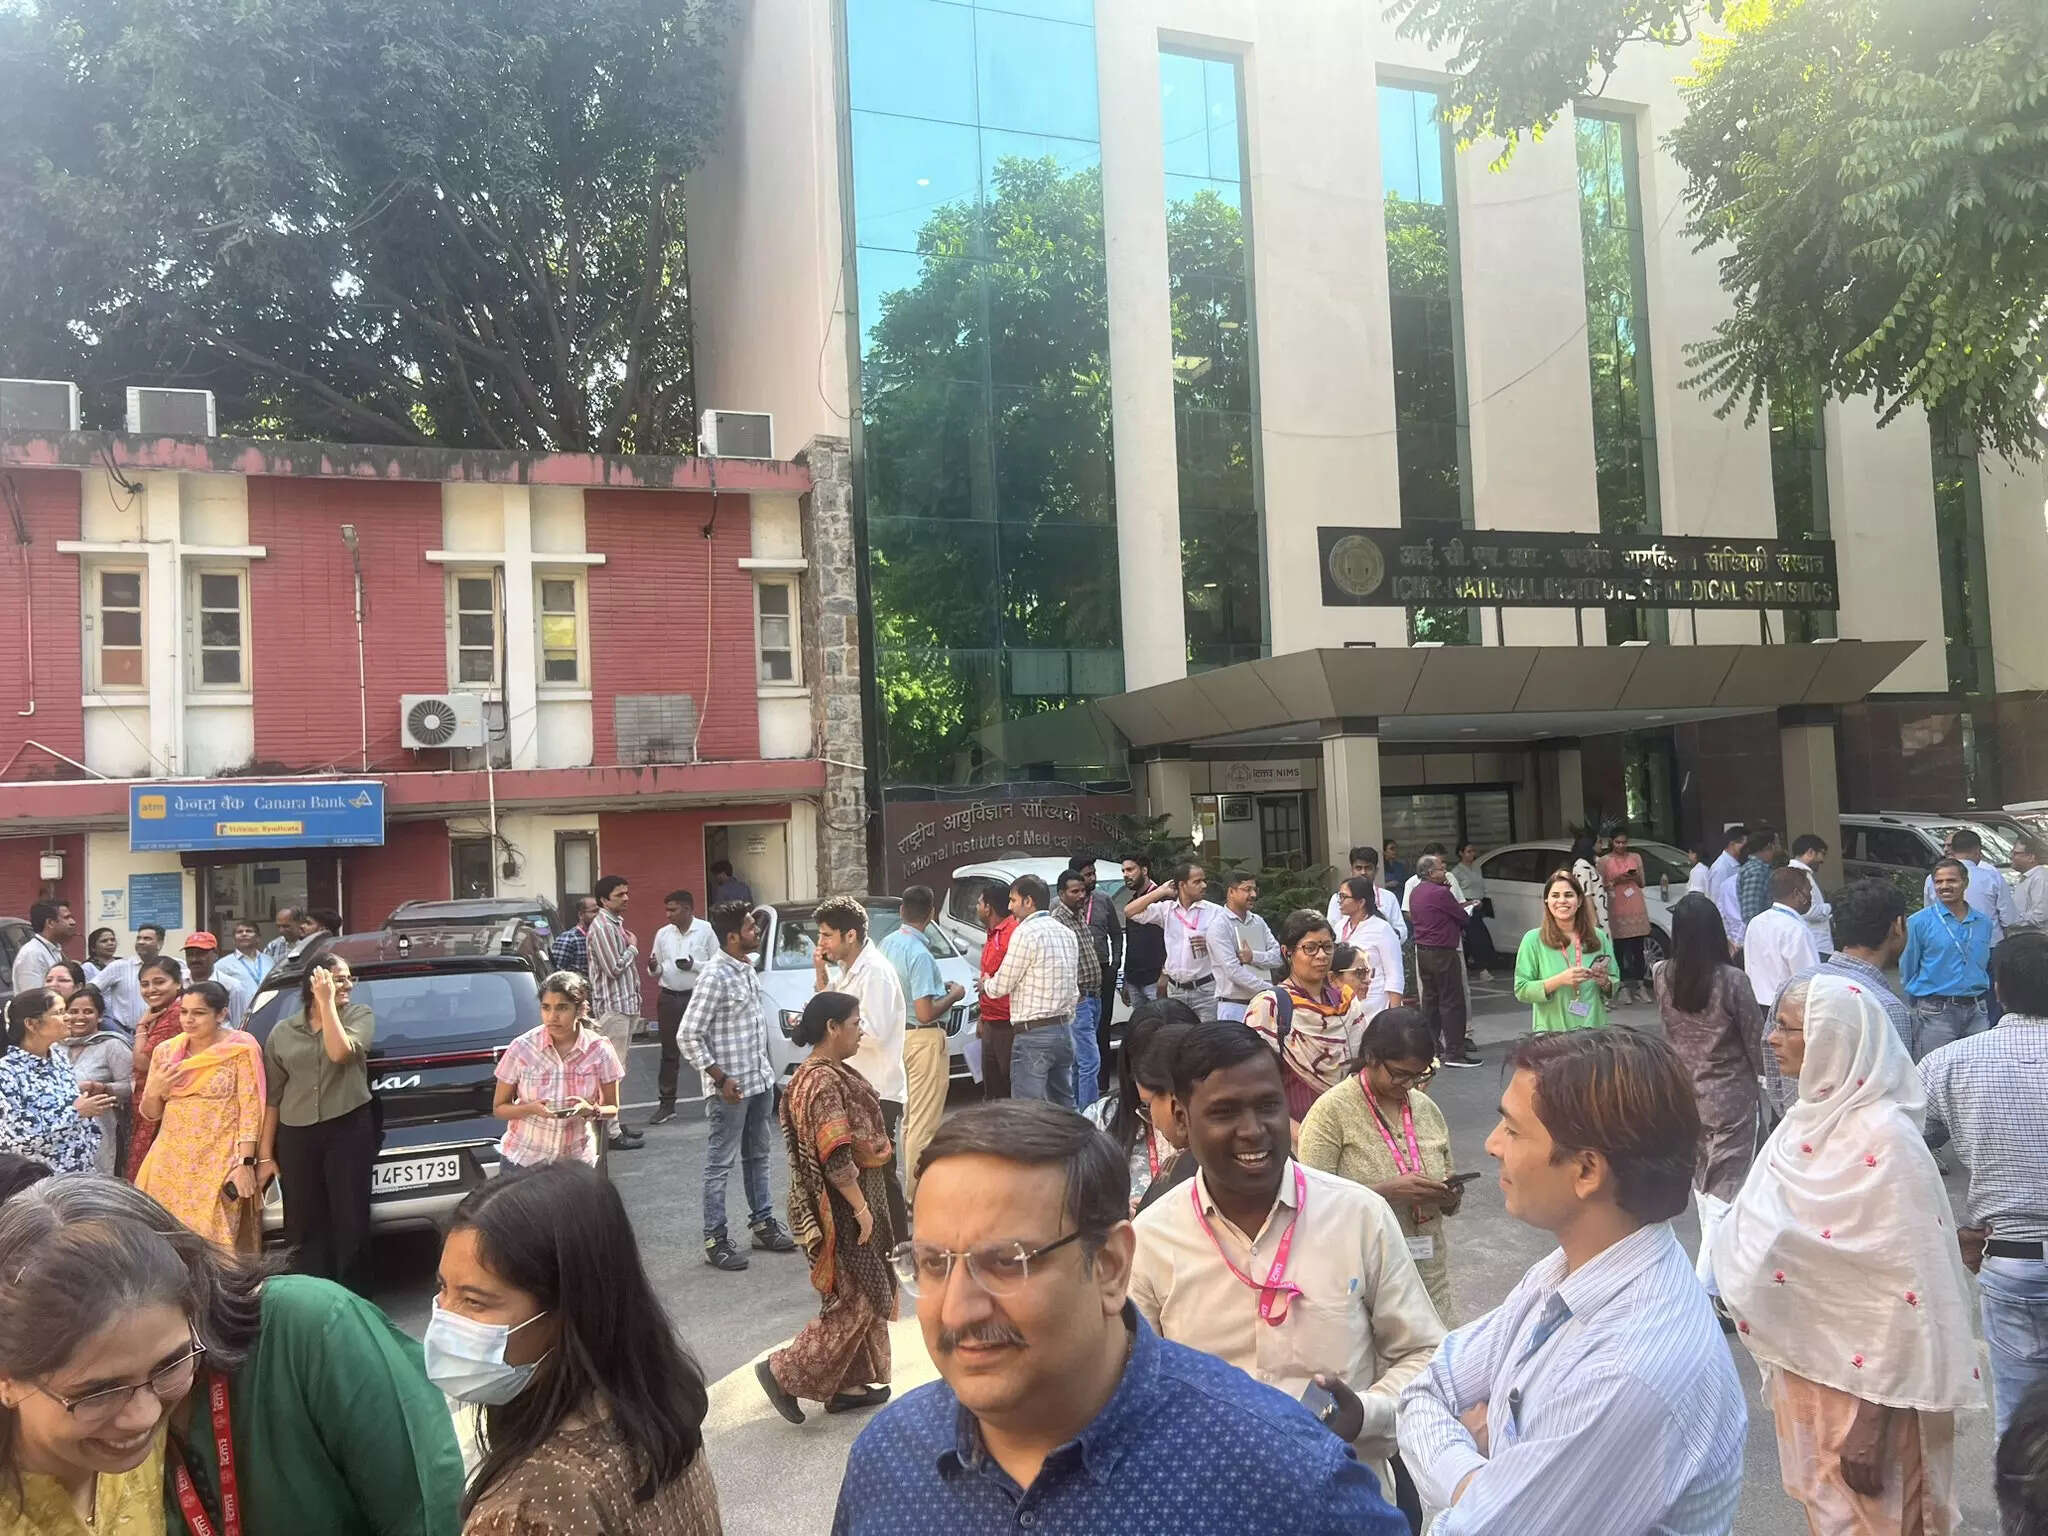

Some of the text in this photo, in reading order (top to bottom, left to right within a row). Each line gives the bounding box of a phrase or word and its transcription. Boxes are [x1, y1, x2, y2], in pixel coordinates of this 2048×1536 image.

[1744, 580, 1833, 603] STATISTICS
[1276, 768, 1300, 777] NIMS
[254, 795, 346, 810] Canara Bank
[897, 821, 936, 855] राष्ट्रीय
[943, 800, 1014, 832] आयुर्विज्ञान
[903, 842, 949, 880] National
[951, 833, 1005, 858] Institute
[1007, 830, 1020, 846] of
